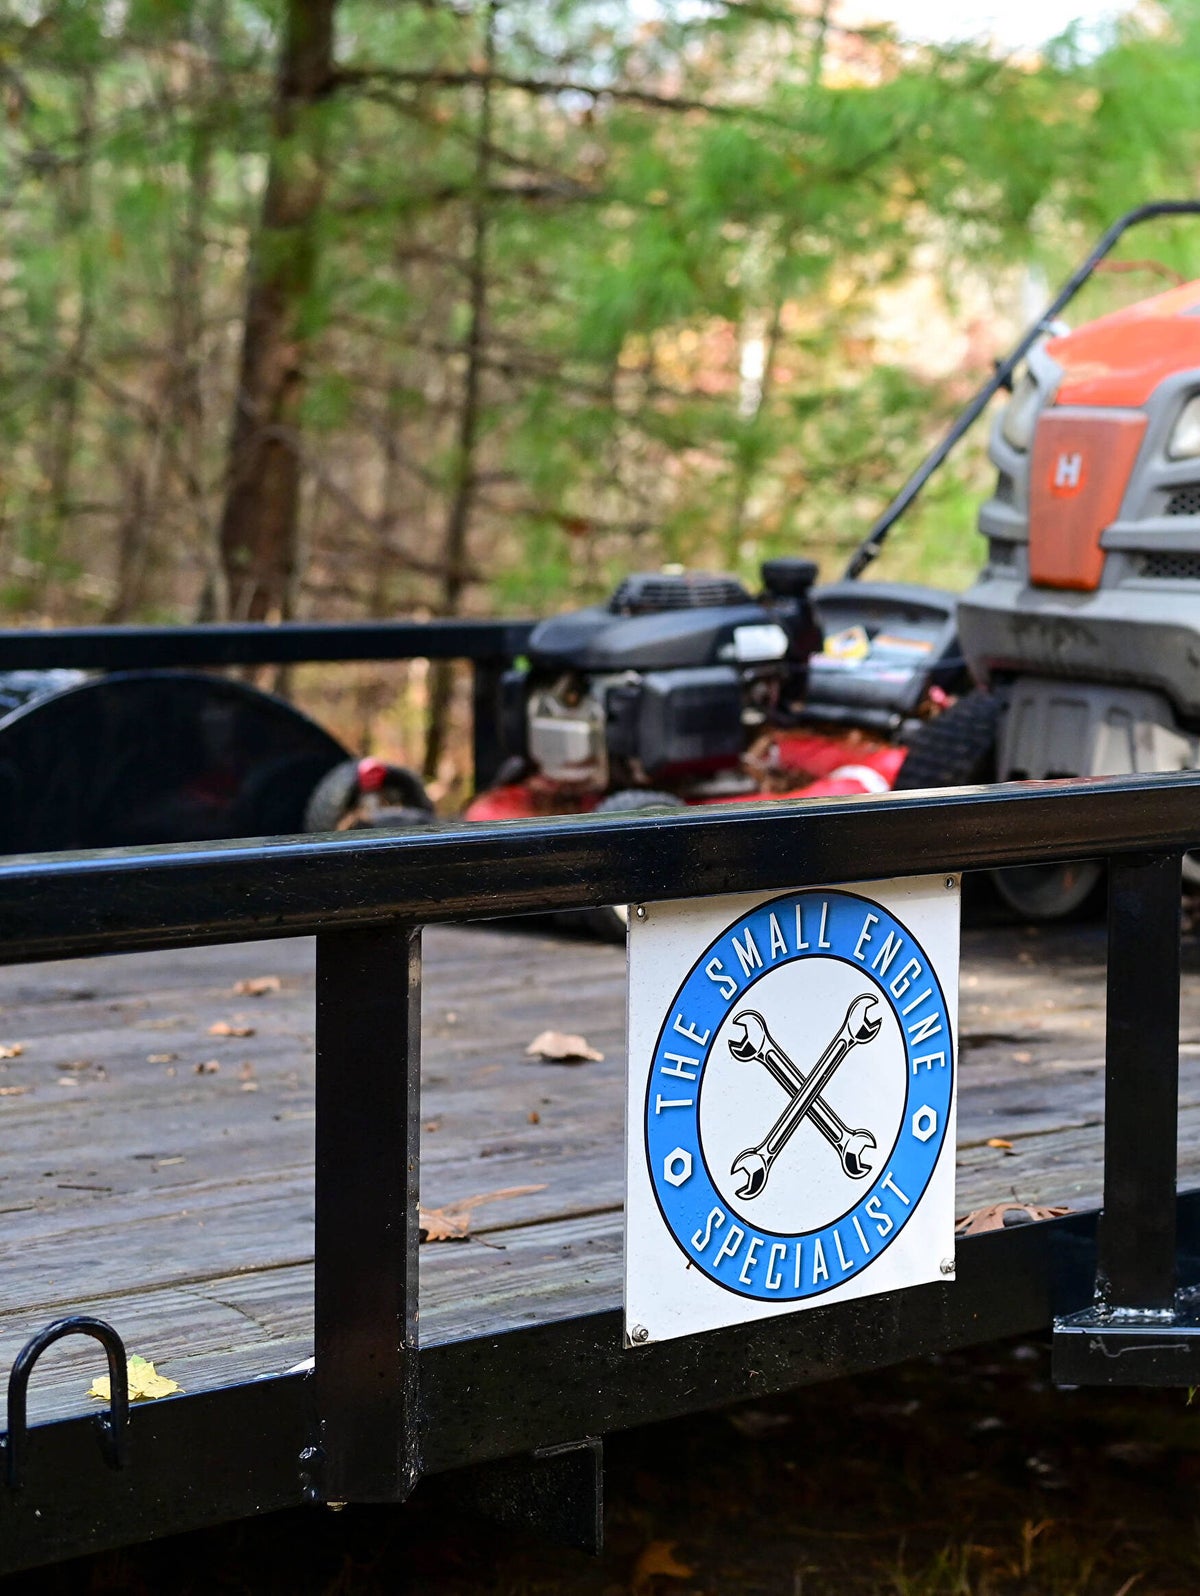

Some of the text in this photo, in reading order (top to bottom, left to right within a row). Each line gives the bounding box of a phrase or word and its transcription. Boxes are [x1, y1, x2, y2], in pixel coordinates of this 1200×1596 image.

[655, 901, 946, 1115] THE SMALL ENGINE
[690, 1171, 911, 1290] SPECIALIST
